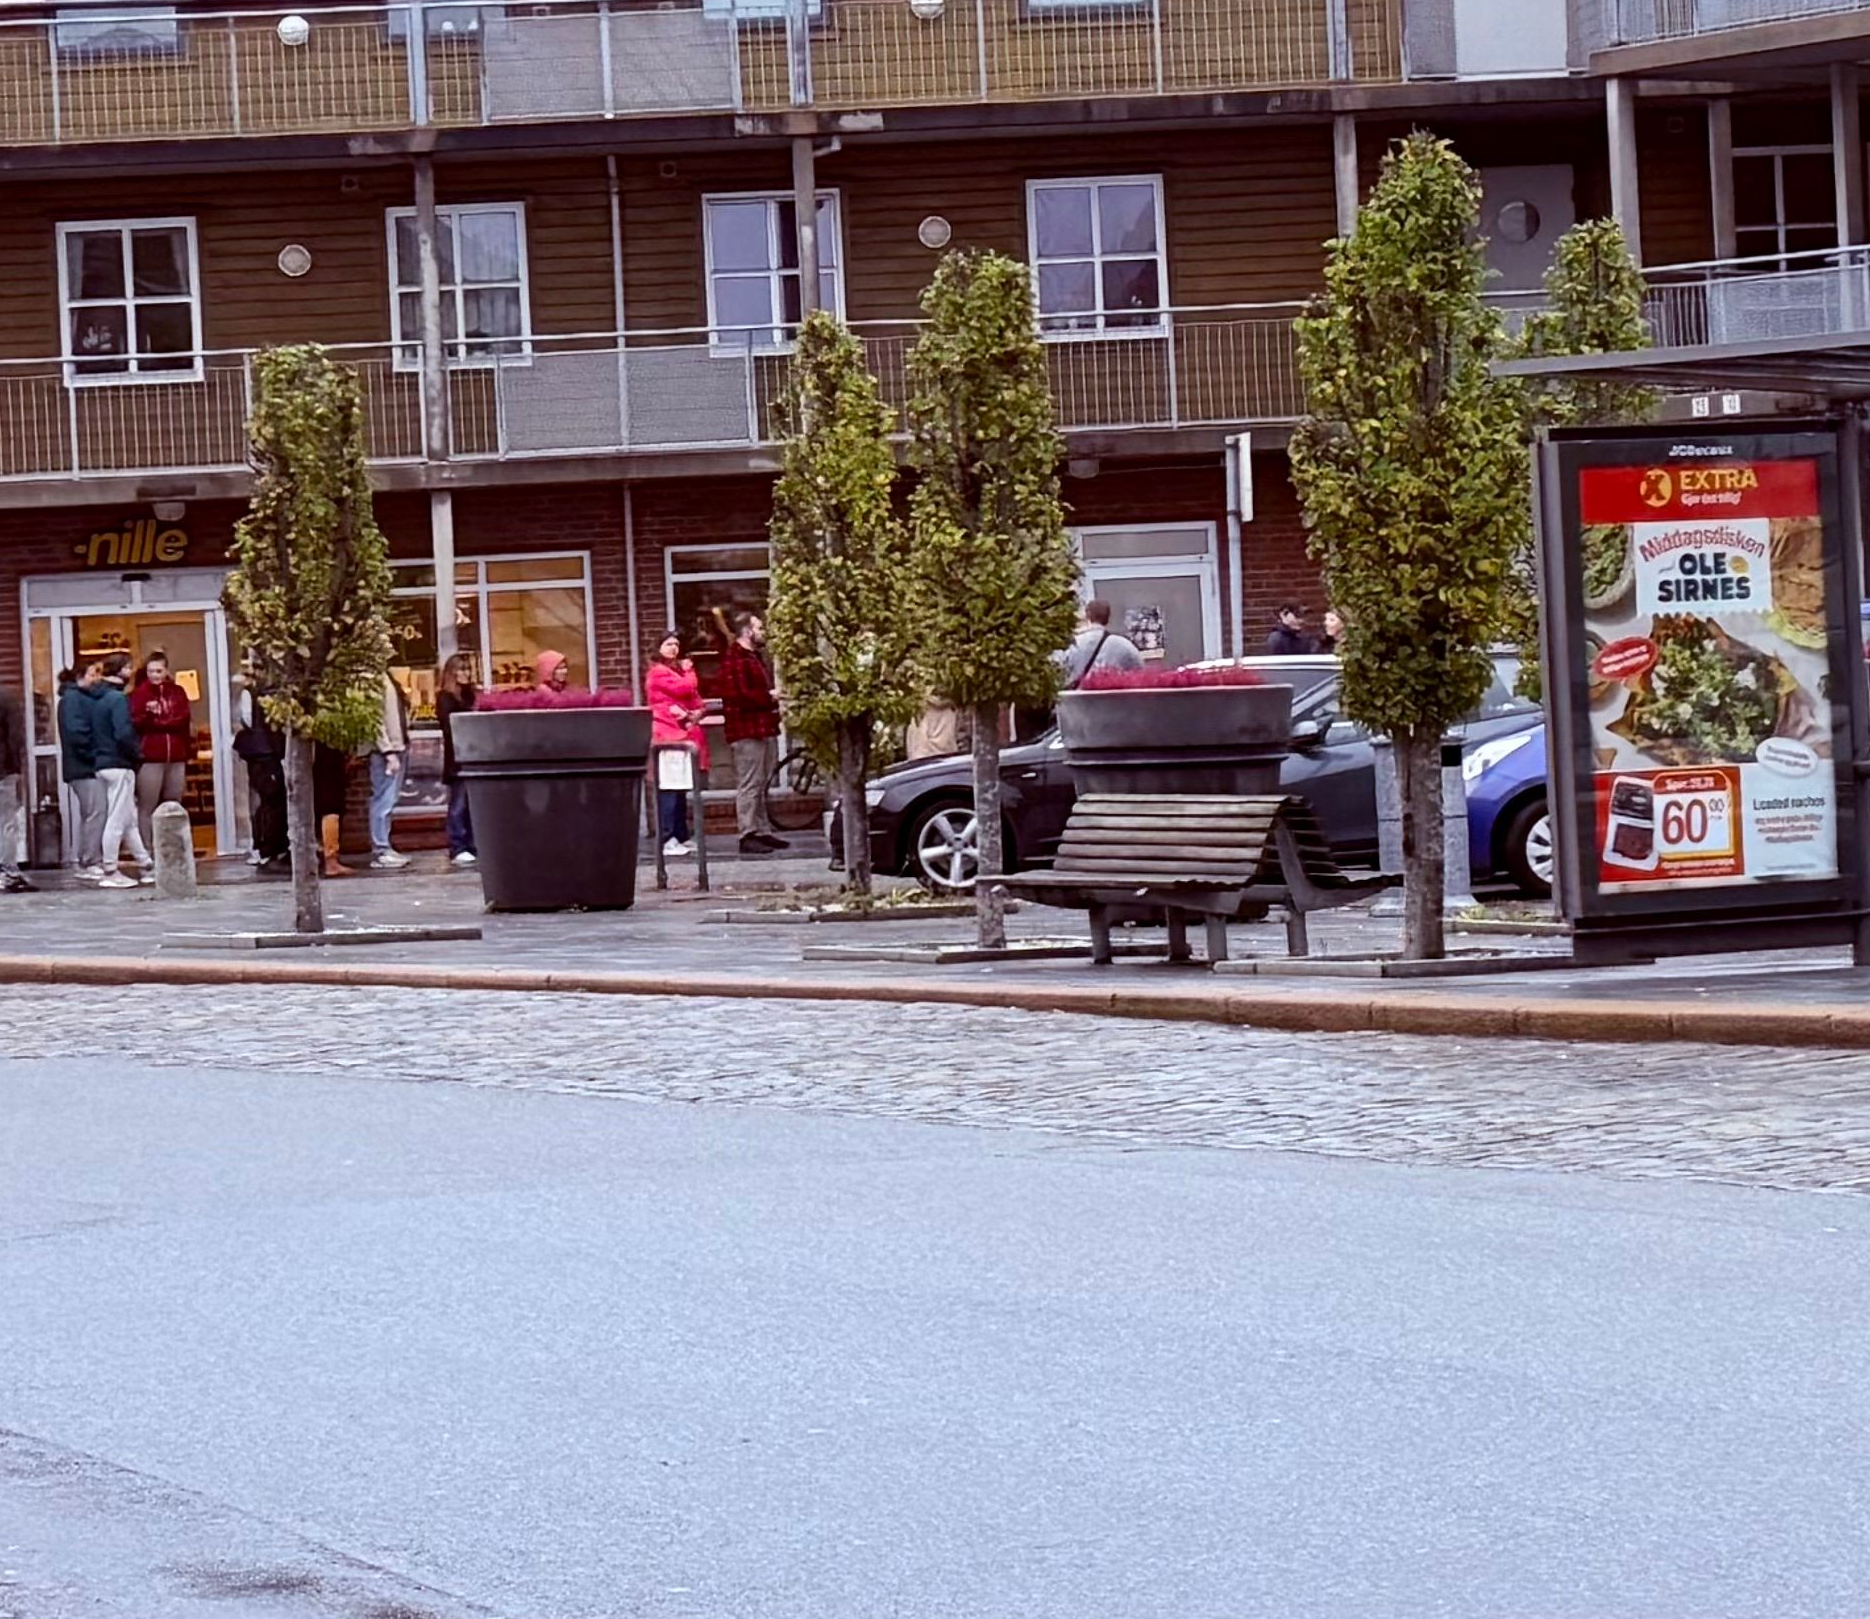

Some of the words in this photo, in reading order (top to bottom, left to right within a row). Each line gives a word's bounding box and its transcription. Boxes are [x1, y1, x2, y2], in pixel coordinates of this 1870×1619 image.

[1679, 468, 1758, 490] EXTRA
[87, 519, 188, 566] nille
[1678, 552, 1727, 575] OLE
[1657, 577, 1751, 602] SIRNES
[1662, 799, 1708, 845] 60
